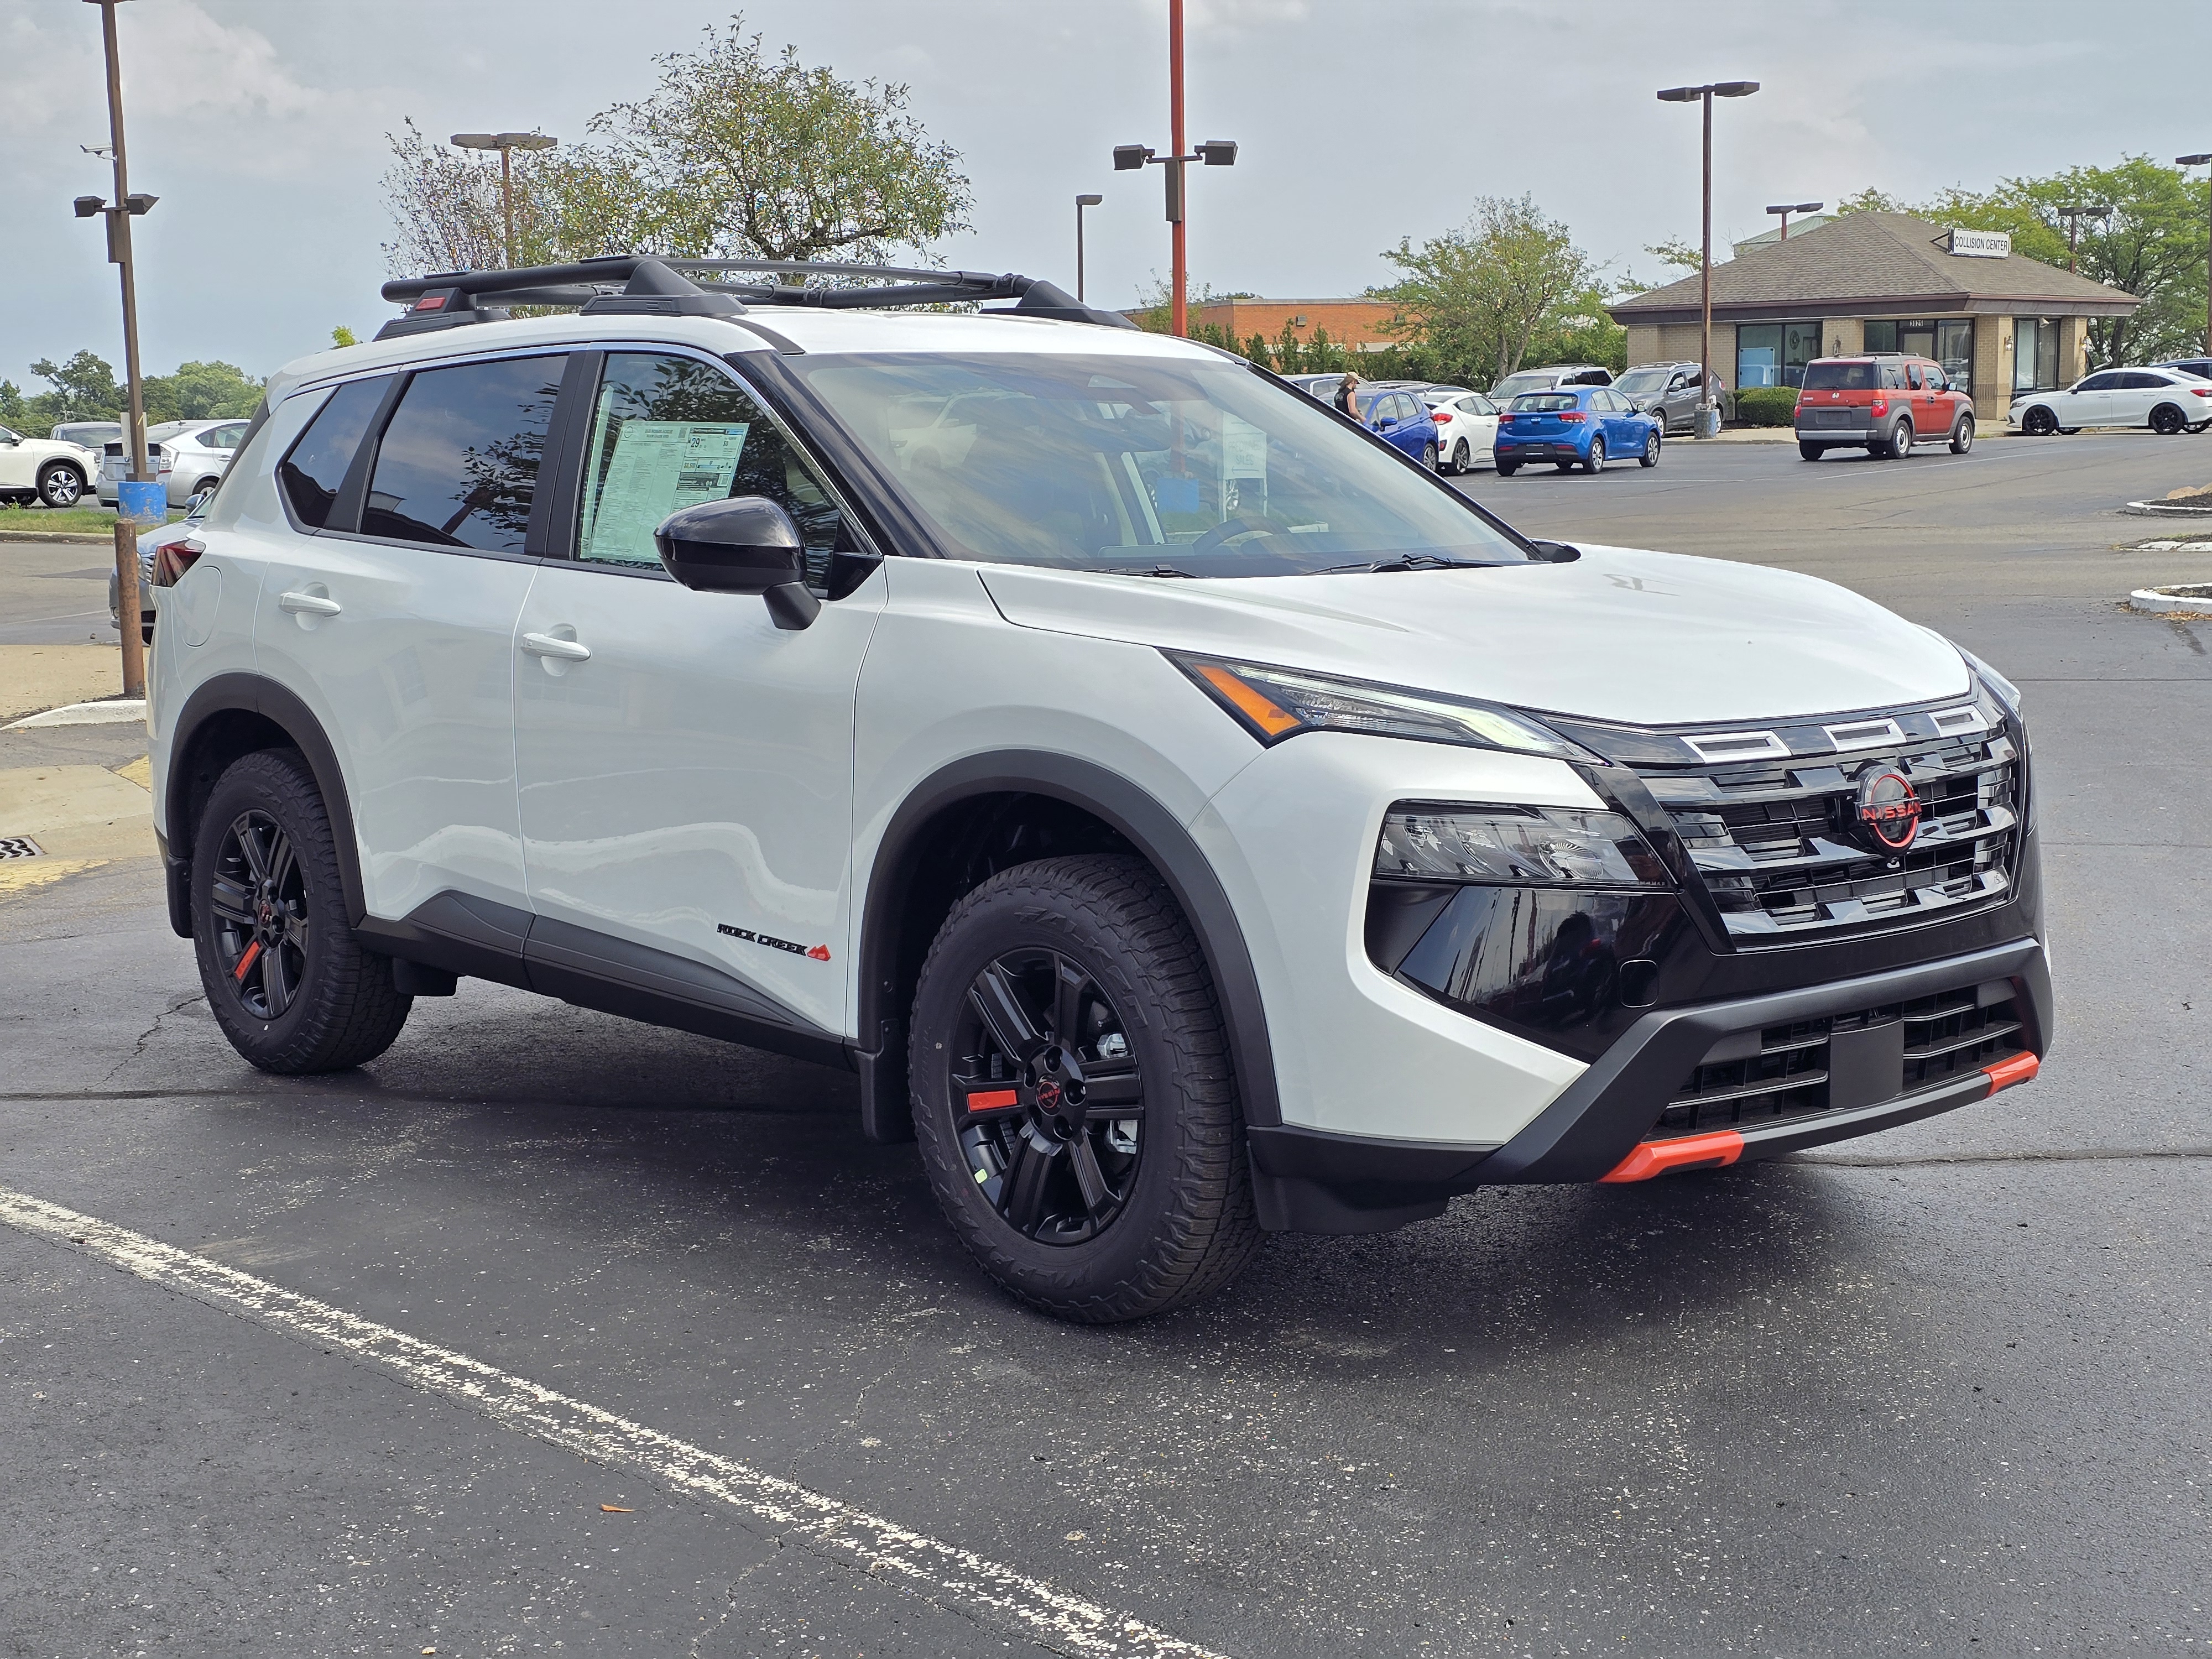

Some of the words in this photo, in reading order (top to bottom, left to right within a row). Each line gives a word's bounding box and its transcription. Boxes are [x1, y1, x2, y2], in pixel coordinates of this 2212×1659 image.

[1955, 236, 1985, 249] COLLISION
[1986, 238, 2008, 252] CENTER
[691, 437, 700, 448] 29
[1235, 454, 1254, 466] SALES
[1862, 801, 1922, 821] NISSAN
[717, 923, 757, 942] ROCK
[757, 934, 808, 957] CREEK
